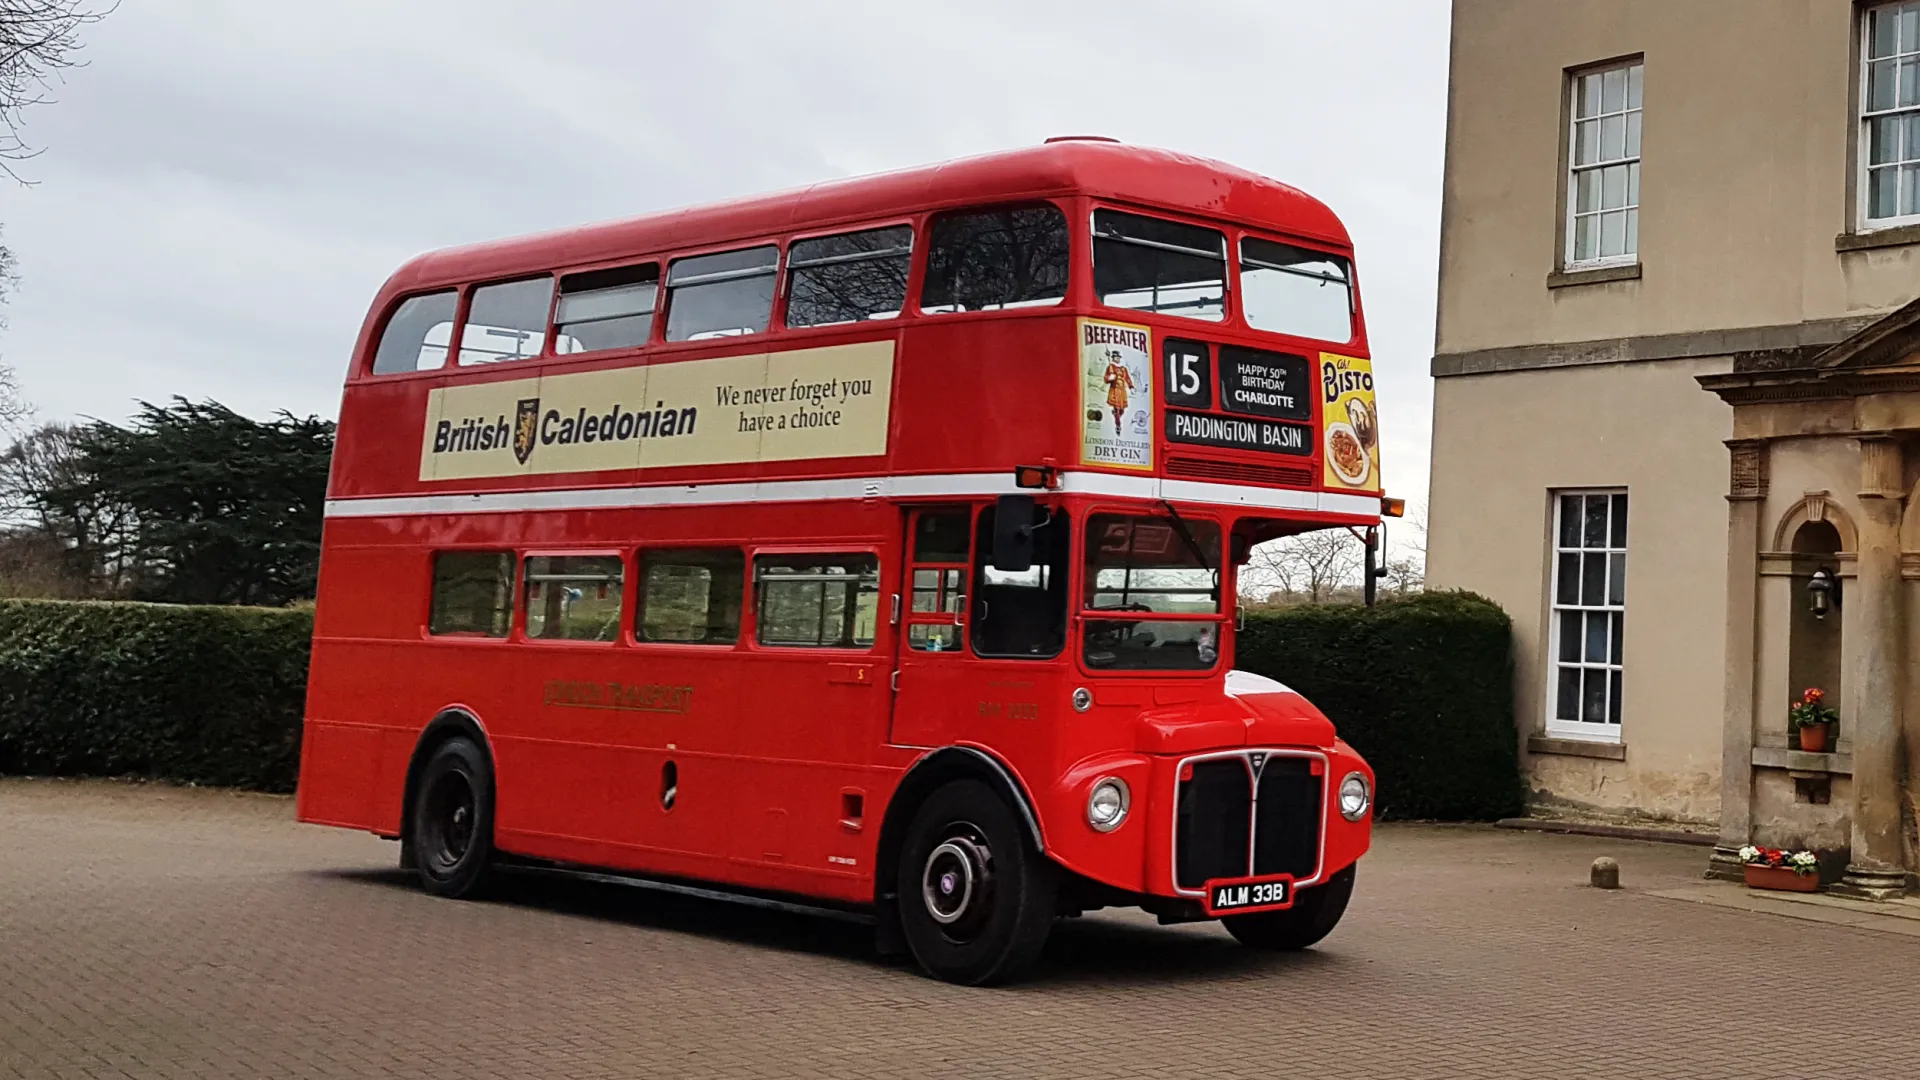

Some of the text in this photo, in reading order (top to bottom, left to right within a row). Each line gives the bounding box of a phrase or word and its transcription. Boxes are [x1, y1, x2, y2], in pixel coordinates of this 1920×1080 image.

[1084, 325, 1147, 353] BEEFEATER
[1170, 353, 1200, 395] 15
[1237, 363, 1268, 377] HAPPY
[1242, 375, 1285, 391] BIRTHDAY
[1323, 362, 1373, 403] BISTO
[716, 378, 872, 406] We never forget you
[1235, 390, 1294, 408] CHARLOTTE
[432, 400, 697, 453] British Caledonian
[737, 404, 841, 432] have a choice
[1175, 415, 1302, 448] PADDINGTON BASIN
[1094, 446, 1142, 460] DRY GIN
[1217, 883, 1283, 906] ALM 33B
